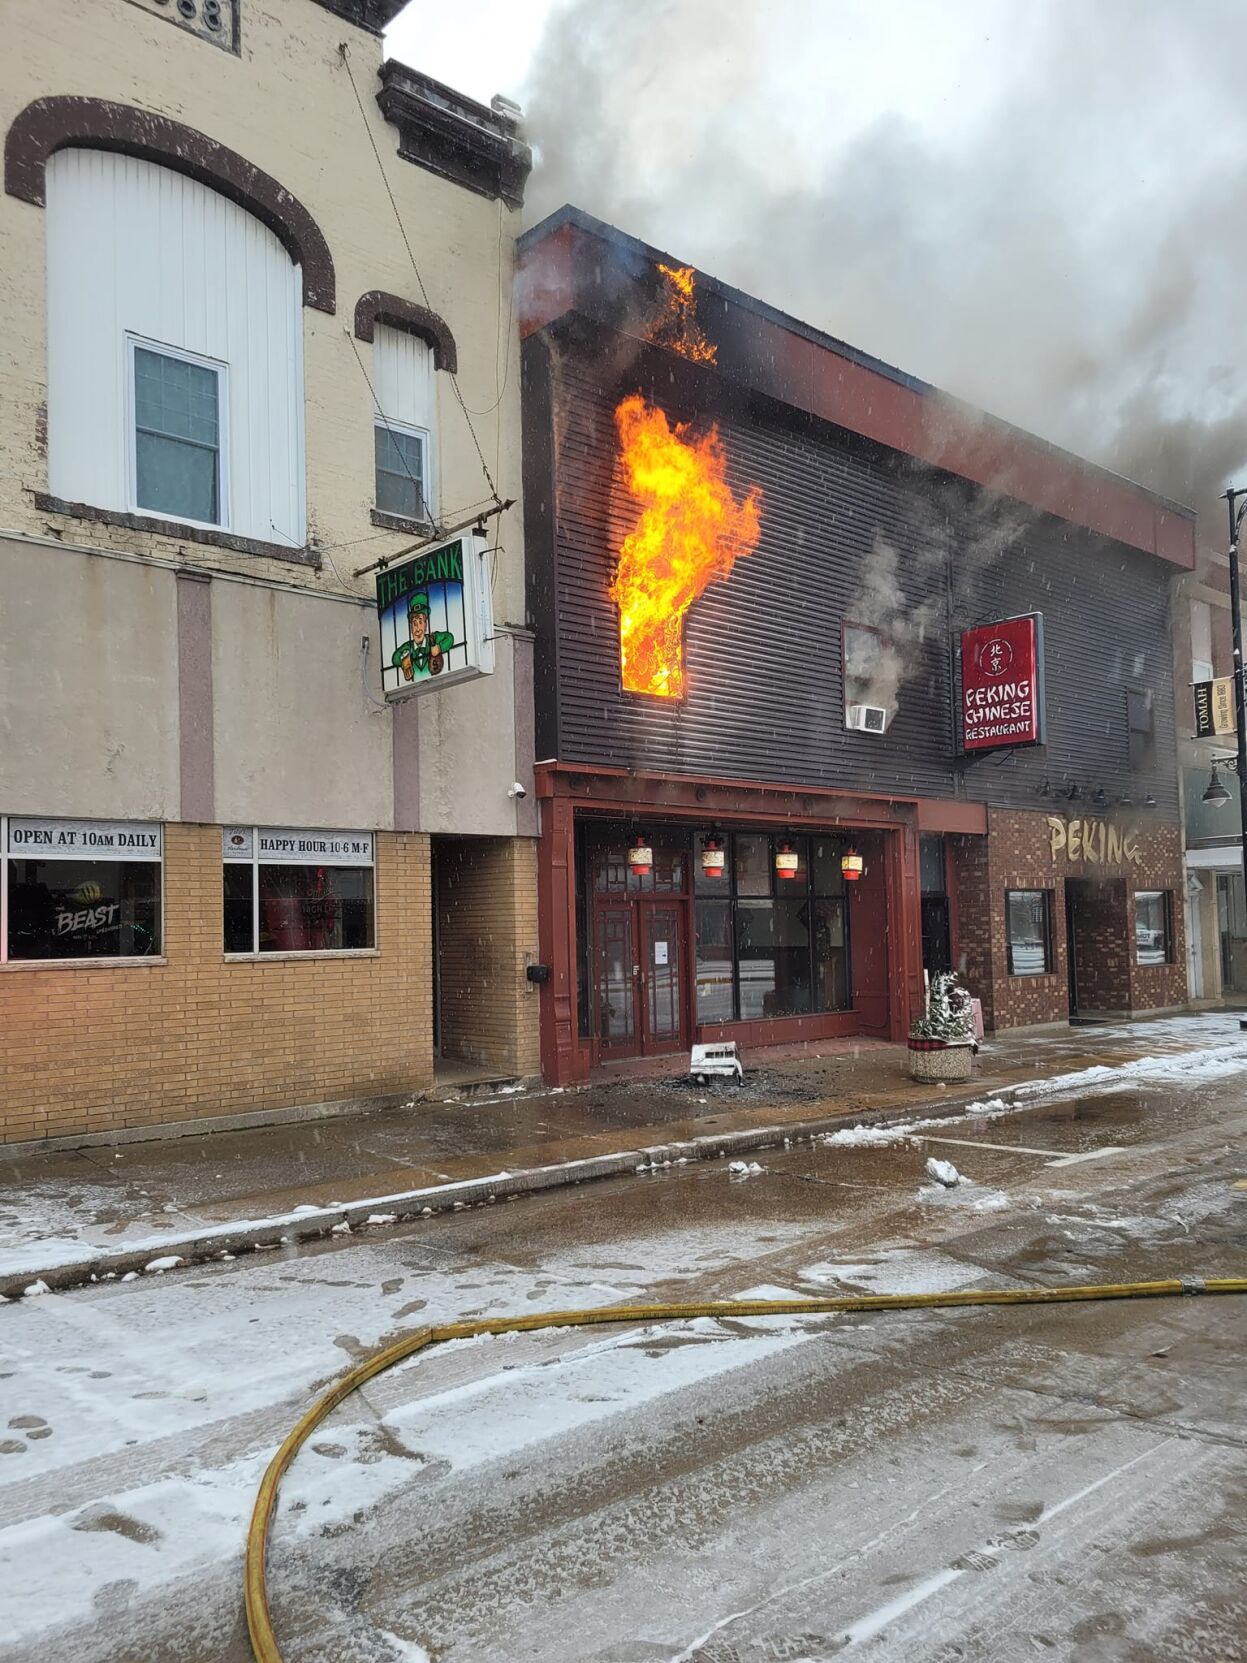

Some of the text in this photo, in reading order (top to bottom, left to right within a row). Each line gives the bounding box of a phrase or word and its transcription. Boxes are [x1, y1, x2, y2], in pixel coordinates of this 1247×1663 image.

[378, 543, 463, 609] THE BANK
[989, 643, 1003, 672] 北京
[965, 680, 1030, 707] PEKING
[965, 701, 1031, 725] CHINESE
[1197, 687, 1209, 732] TOMAH
[965, 721, 1031, 741] RESTAURANT
[13, 829, 157, 848] OPEN AT 10AM DAILY
[260, 838, 296, 852] HAPPY
[298, 840, 327, 853] HOUR
[330, 842, 350, 853] 10-6
[1046, 816, 1143, 865] PEKING
[55, 903, 120, 936] BEAST
